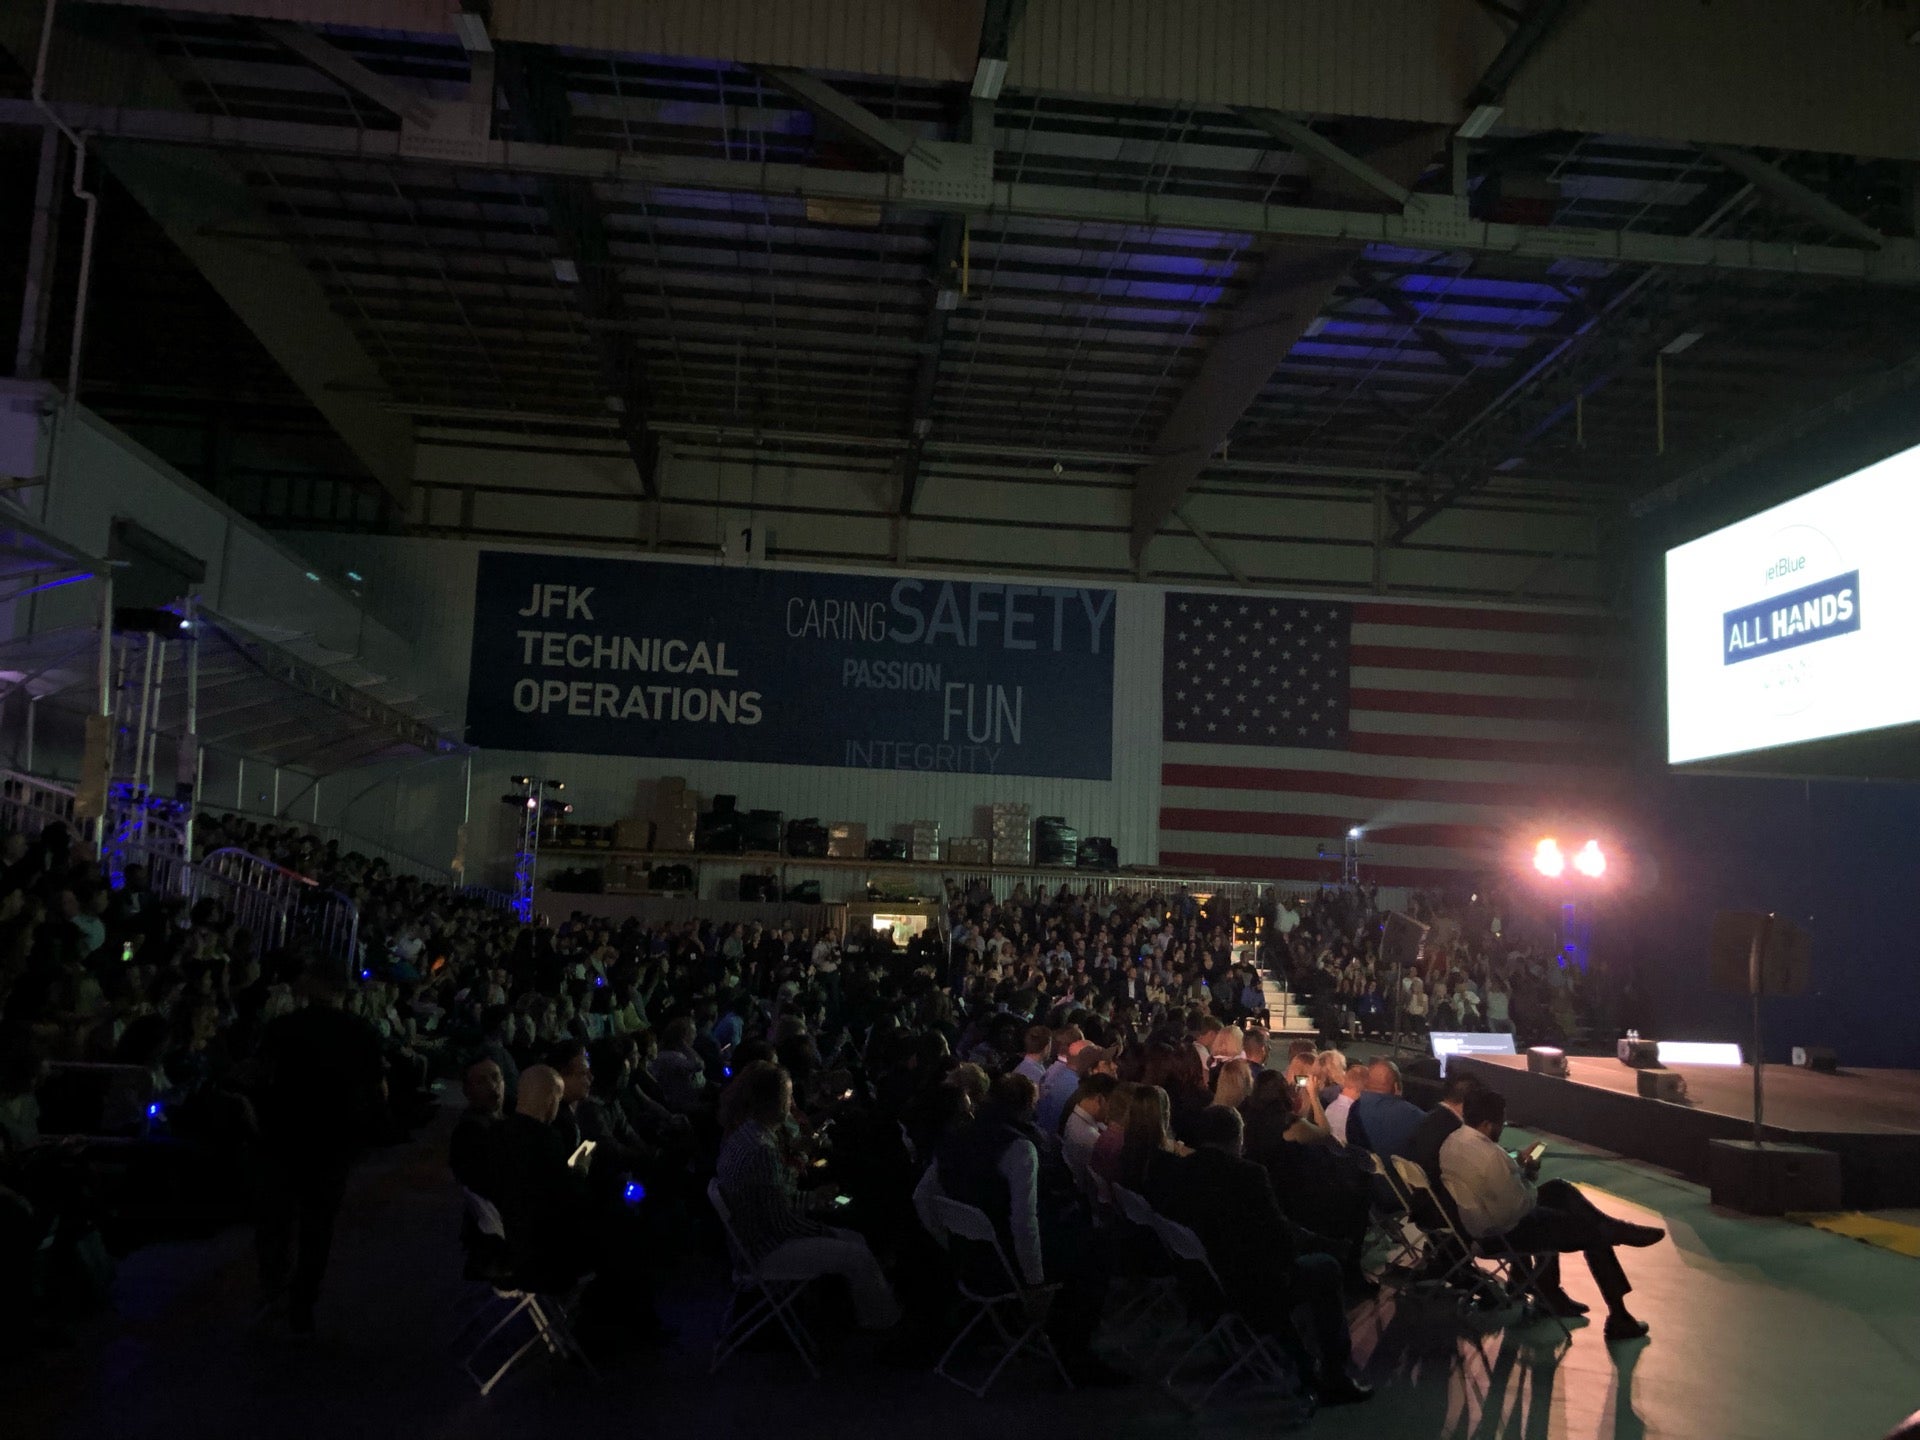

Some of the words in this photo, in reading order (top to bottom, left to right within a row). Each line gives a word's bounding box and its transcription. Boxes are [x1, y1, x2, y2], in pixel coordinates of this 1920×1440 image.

[741, 528, 752, 552] 1
[1764, 556, 1806, 585] jetBlue
[518, 583, 595, 620] JFK
[786, 597, 886, 642] CARING
[889, 579, 1116, 654] SAFETY
[1729, 617, 1768, 652] ALL
[1771, 589, 1854, 639] HANDS
[517, 630, 739, 677] TECHNICAL
[842, 658, 941, 692] PASSION
[513, 678, 762, 725] OPERATIONS
[943, 682, 1022, 745] FUN
[845, 739, 1002, 772] INTEGRITY
